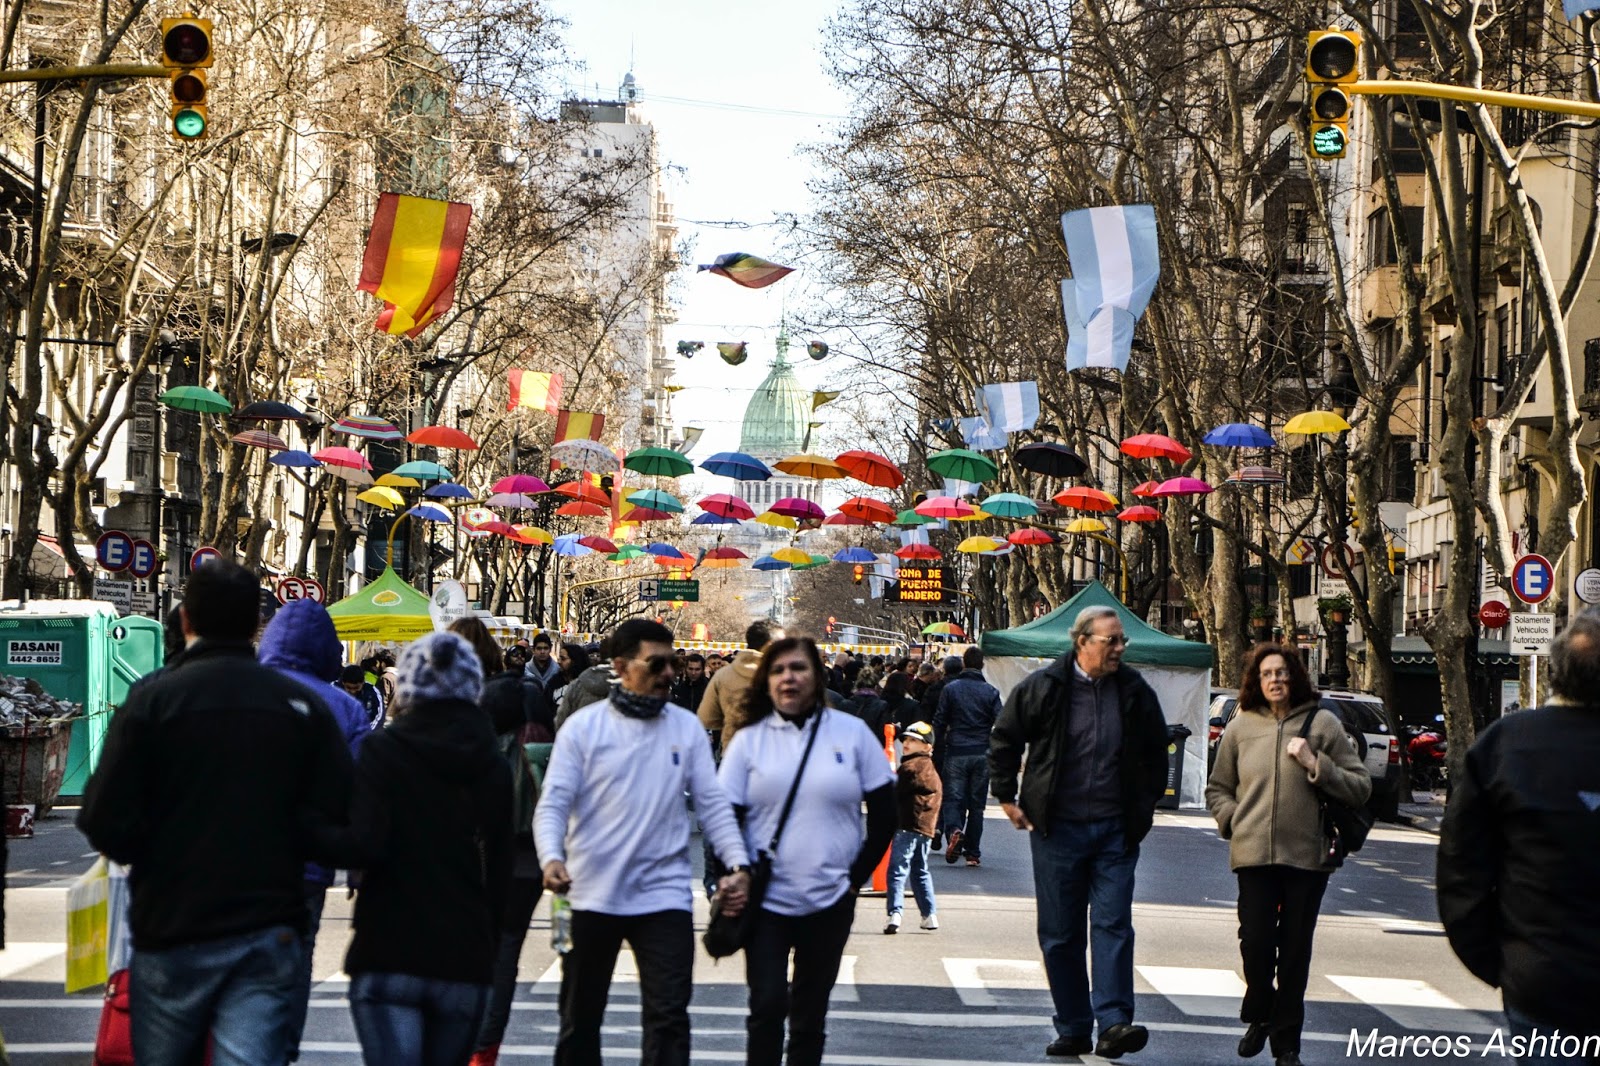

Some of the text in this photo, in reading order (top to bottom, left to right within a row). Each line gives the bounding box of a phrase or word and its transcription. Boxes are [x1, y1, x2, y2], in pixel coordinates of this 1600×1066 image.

[106, 538, 124, 565] E
[895, 568, 942, 579] ZONA DE
[1524, 563, 1542, 595] E
[95, 579, 129, 590] Solamente
[900, 580, 942, 589] PUERTO
[900, 590, 942, 600] MADERO
[1482, 610, 1504, 618] Claro
[1514, 615, 1551, 625] Solamente
[1516, 626, 1549, 634] Vehiculos
[10, 642, 60, 652] BASANI
[10, 655, 61, 663] 4442-8652
